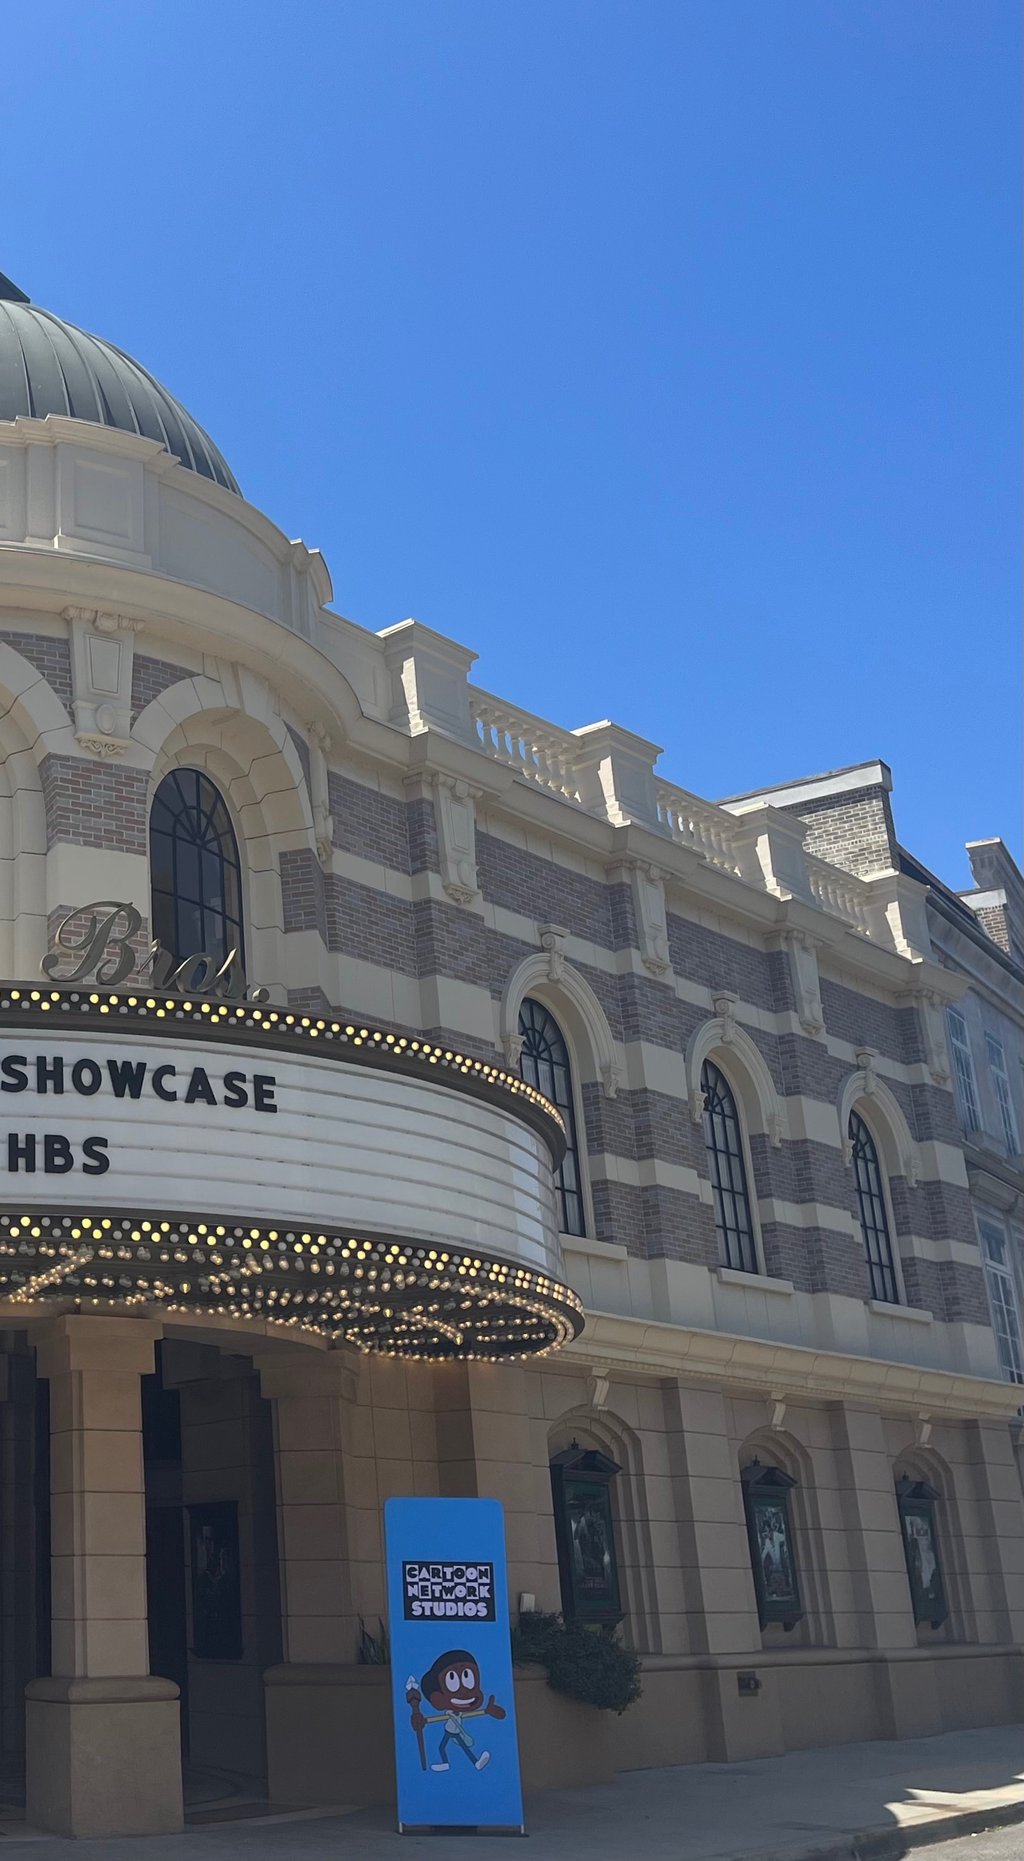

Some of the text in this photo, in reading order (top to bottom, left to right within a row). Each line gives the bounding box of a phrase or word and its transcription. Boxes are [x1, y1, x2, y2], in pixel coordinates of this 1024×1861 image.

[40, 901, 270, 1002] Bros.
[0, 1055, 278, 1113] SHOWCASE
[8, 1132, 110, 1175] HBS
[406, 1565, 490, 1583] CARTOON
[407, 1582, 491, 1599] NETWORK
[411, 1601, 488, 1617] STUDIOS
